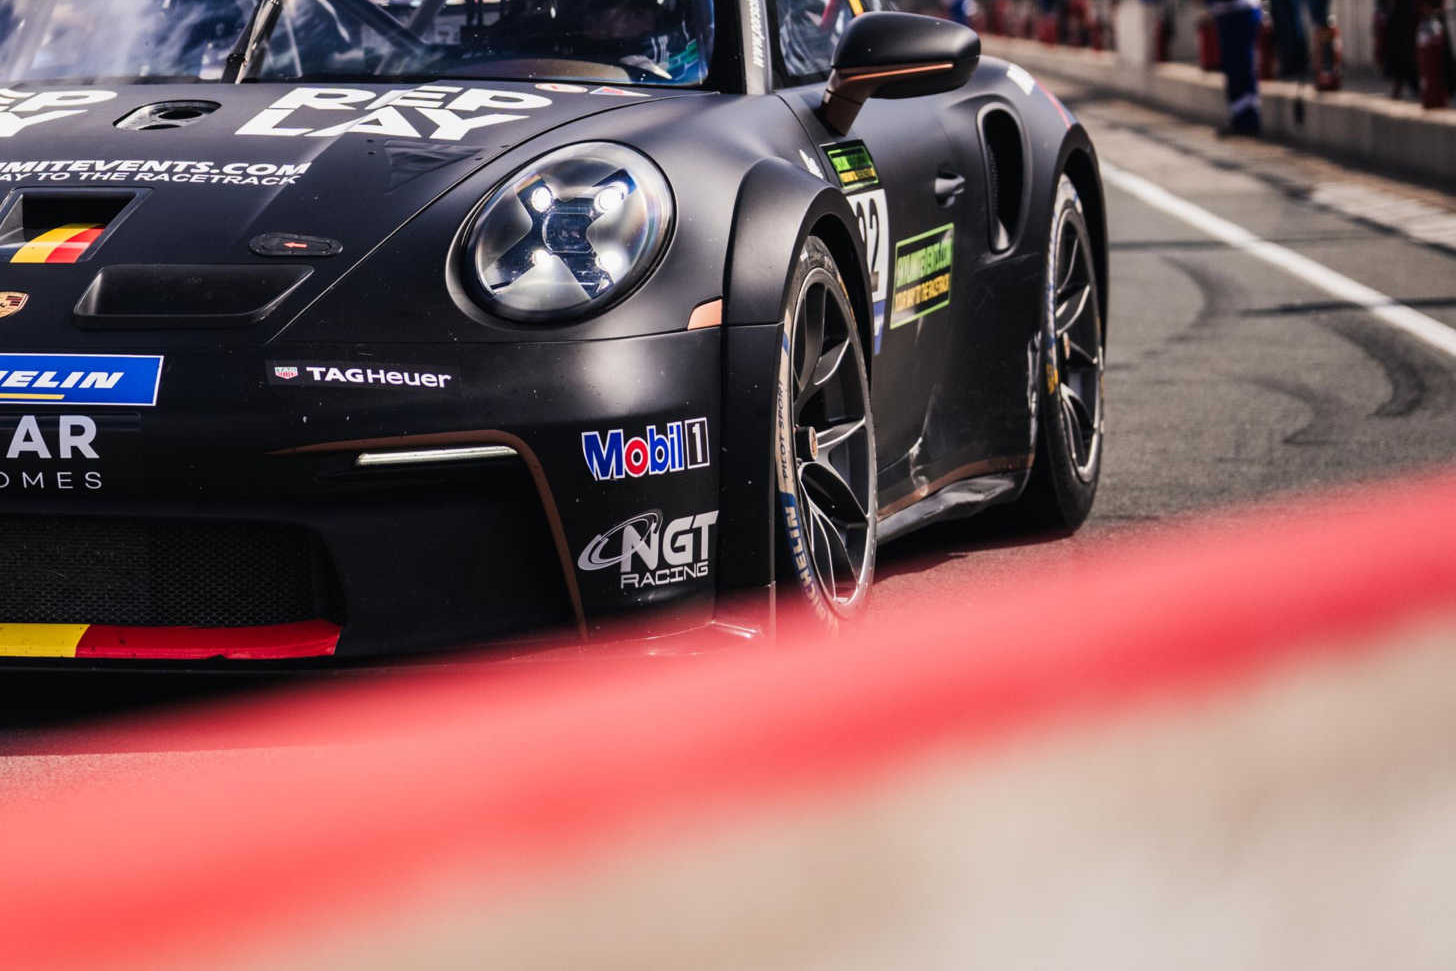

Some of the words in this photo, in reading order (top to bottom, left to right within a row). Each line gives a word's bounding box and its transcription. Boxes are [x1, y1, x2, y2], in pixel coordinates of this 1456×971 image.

[268, 85, 553, 111] REP
[234, 106, 531, 141] LAY
[38, 171, 75, 182] TO
[85, 171, 139, 182] THE
[142, 172, 302, 186] RACETRACK
[620, 510, 719, 573] NGT
[621, 561, 709, 589] RACING
